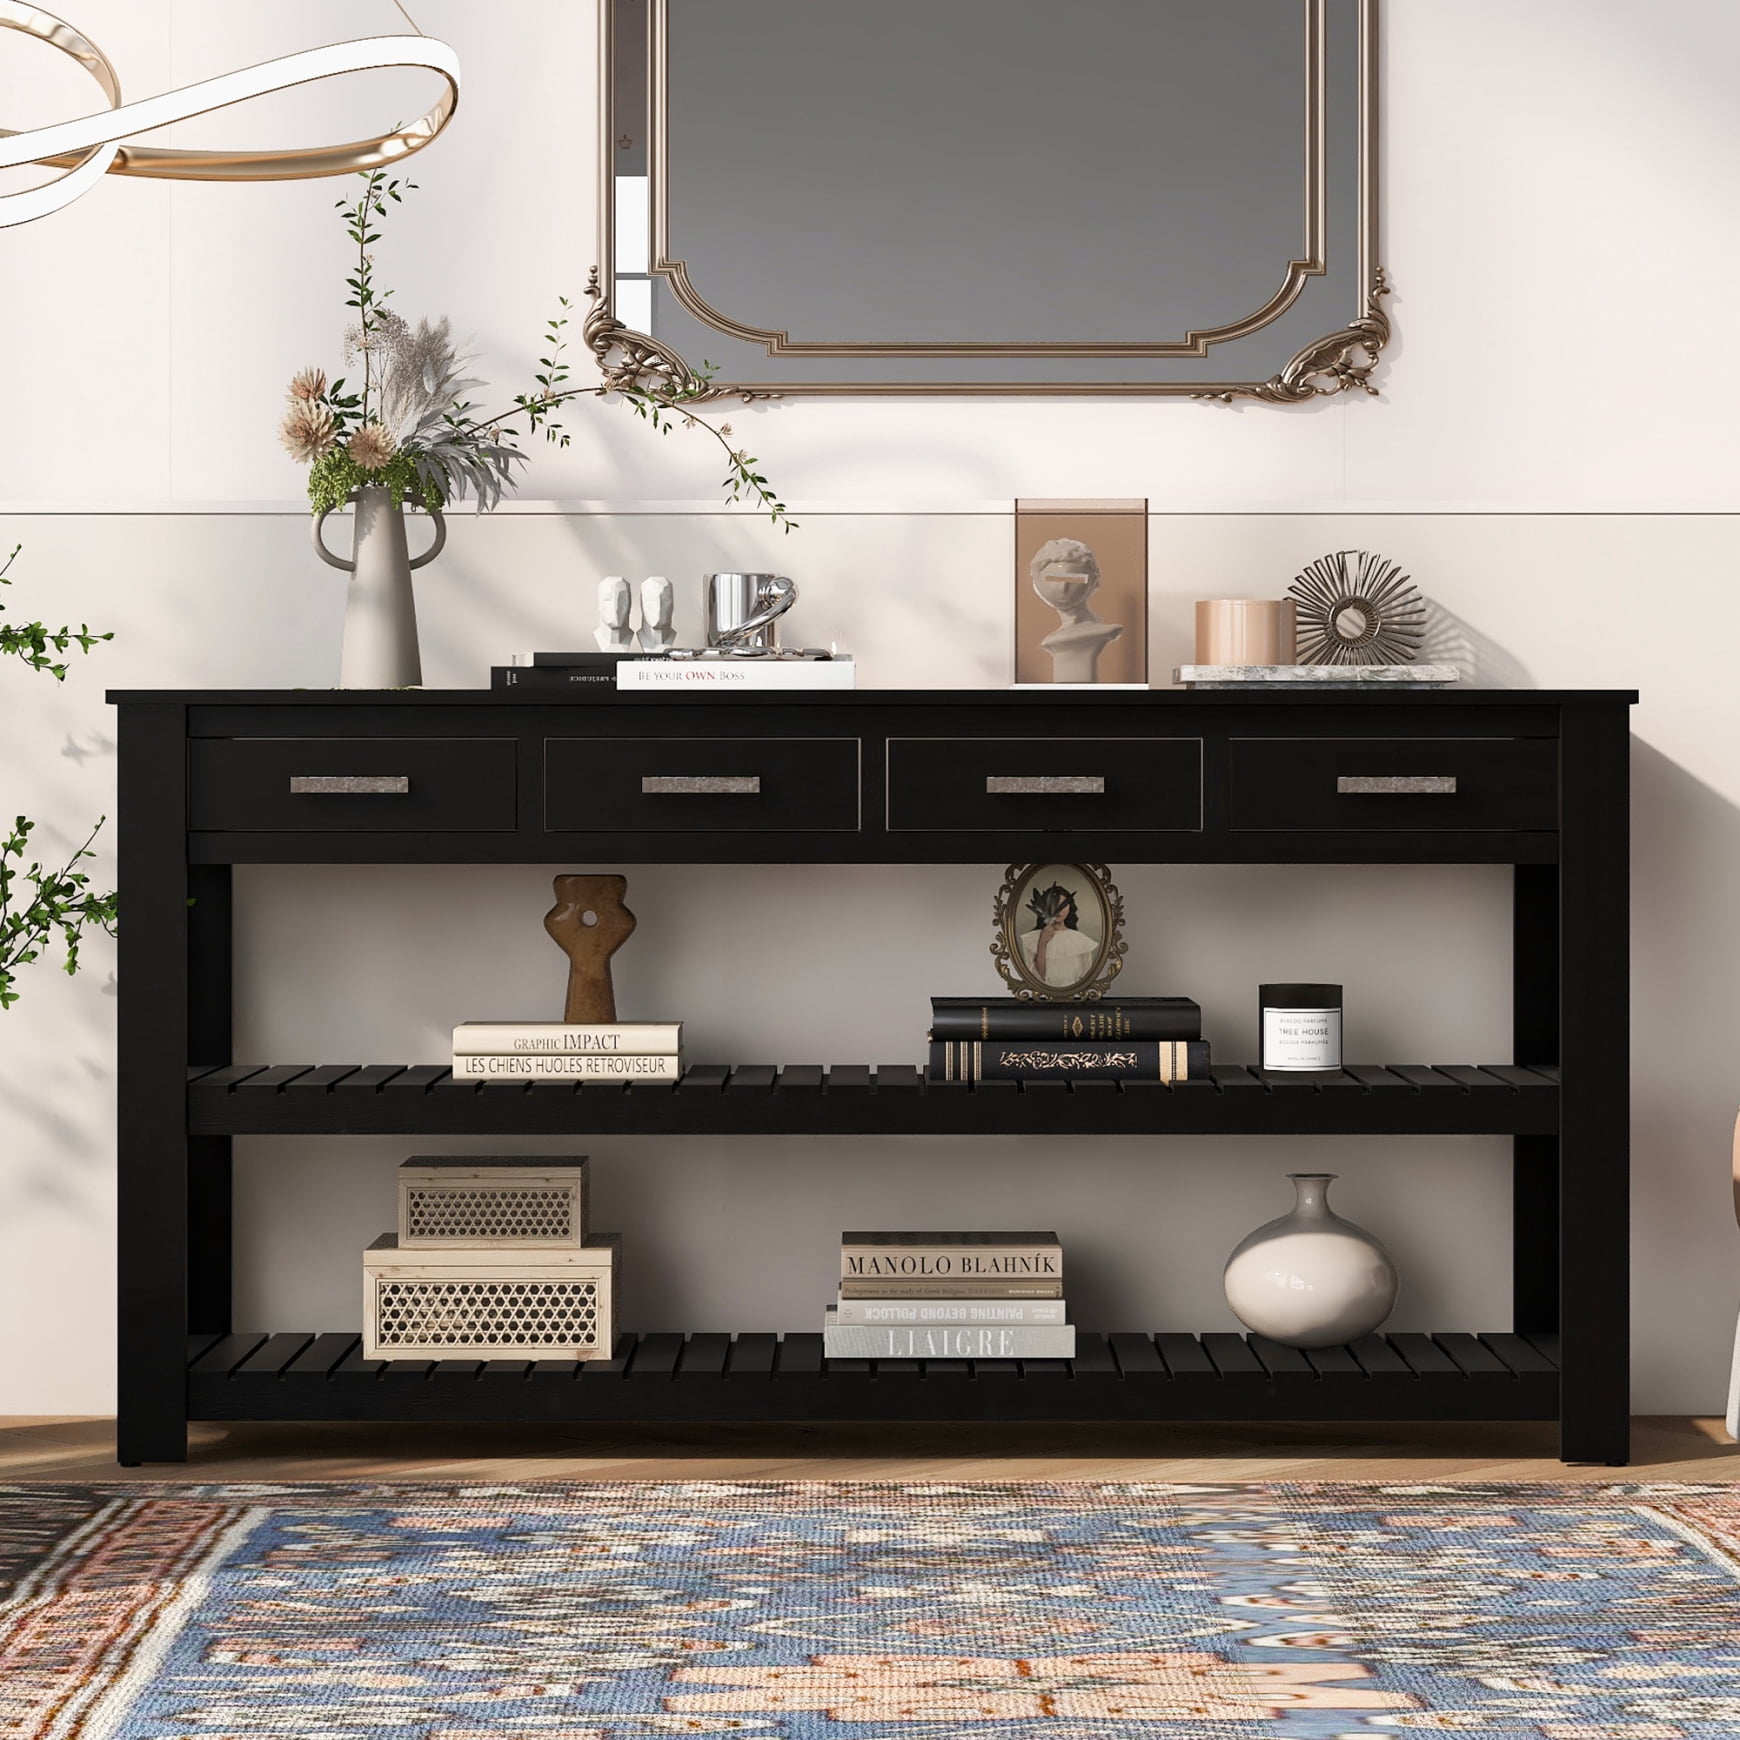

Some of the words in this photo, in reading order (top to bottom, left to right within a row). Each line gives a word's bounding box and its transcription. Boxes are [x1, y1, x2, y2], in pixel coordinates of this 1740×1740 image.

[638, 671, 650, 680] BE
[653, 671, 683, 680] YOUR
[685, 671, 716, 681] OWN
[1279, 1028, 1300, 1036] TREE
[1302, 1028, 1329, 1036] HOUSE
[514, 1038, 561, 1050] GRAPHIC
[563, 1034, 621, 1050] IMPACT
[466, 1058, 486, 1073] LES
[489, 1058, 532, 1073] CHIENS
[536, 1058, 583, 1073] HUOLES
[586, 1058, 666, 1073] RETROVISEUR
[848, 1255, 951, 1274] MANOLO
[961, 1252, 1055, 1273] BLAHNÍK
[864, 1307, 917, 1320] POLLOCK
[920, 1307, 966, 1320] BEYOND
[970, 1307, 1024, 1320] PAINTING
